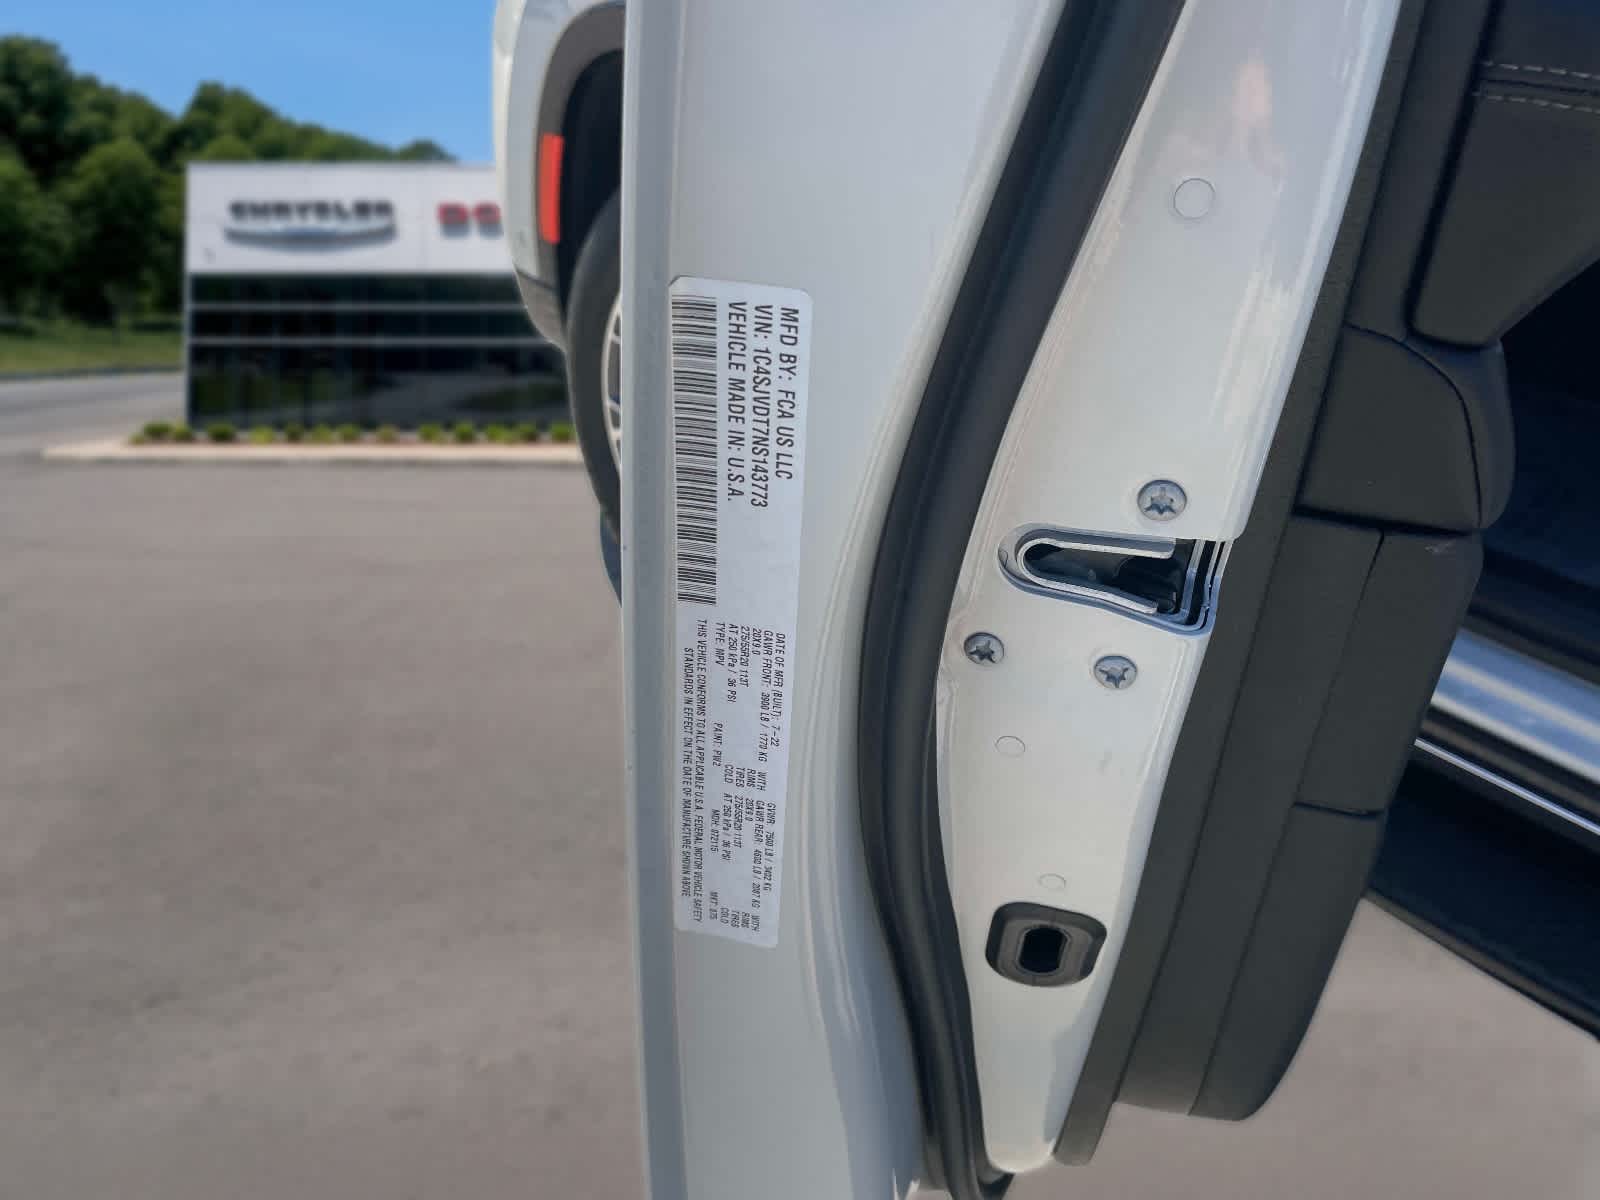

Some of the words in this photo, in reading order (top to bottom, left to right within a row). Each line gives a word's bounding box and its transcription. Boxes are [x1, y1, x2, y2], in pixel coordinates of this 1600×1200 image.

[754, 305, 772, 339] VIN:
[780, 308, 798, 346] MFD
[728, 302, 746, 370] VEHICLE
[779, 353, 797, 380] BY:
[728, 378, 745, 424] MADE
[778, 390, 795, 418] FCA
[751, 348, 772, 507] 1C4SJVDT7NS143773
[777, 427, 793, 447] US
[728, 431, 744, 450] IN:
[776, 453, 792, 479] LLC
[728, 458, 744, 501] U.S.A.
[697, 619, 707, 637] THIS
[729, 624, 738, 633] AT
[728, 637, 737, 650] 250
[740, 626, 750, 666] 275/55R20
[752, 628, 761, 655] 20X9.0
[764, 631, 773, 655] GAWR
[776, 633, 785, 654] DATE
[697, 640, 706, 672] VEHICLE
[715, 648, 724, 665] MPV
[728, 654, 737, 666] kPa
[775, 656, 784, 667] OF
[684, 648, 694, 694] STANDARDS
[740, 670, 748, 687] 113T
[762, 658, 772, 688] FRONT:
[774, 670, 783, 687] MFR
[728, 678, 736, 686] 36
[697, 674, 706, 715] CONFORMS
[728, 690, 736, 702] PSI
[761, 692, 770, 709] 3900
[684, 708, 692, 734] EFFECT
[696, 719, 705, 728] TO
[760, 713, 768, 721] LB
[684, 738, 692, 747] ON
[696, 730, 705, 744] ALL
[713, 723, 722, 746] PAINT:
[759, 733, 767, 749] 1770
[683, 750, 692, 764] THE
[712, 750, 722, 766] PW2
[758, 752, 767, 762] KG
[683, 767, 692, 785] DATE
[695, 746, 704, 790] APPLICABLE
[725, 764, 733, 783] COLD
[736, 768, 744, 787] TIRES
[746, 768, 756, 787] RIMS
[757, 772, 766, 790] WITH
[683, 788, 691, 796] OF
[724, 793, 732, 803] AT
[694, 792, 704, 812] U.S.A.
[724, 805, 732, 817] 250
[745, 798, 754, 821] 20X9.0
[756, 800, 764, 822] GAWR
[712, 809, 720, 826] MDH:
[734, 796, 743, 830] 275/55R20
[682, 798, 691, 848] MANUFACTURE
[694, 816, 703, 844] FEDERAL
[723, 819, 731, 830] kPa
[722, 840, 730, 848] 36
[765, 848, 773, 856] LB
[682, 851, 690, 874] SHOWN
[694, 847, 702, 869] MOTOR
[722, 850, 730, 860] PSI
[753, 866, 761, 874] LB
[682, 876, 690, 896] ABOVE
[694, 872, 702, 896] VEHICLE
[694, 899, 702, 922] SAFETY
[752, 899, 760, 908] KG
[752, 916, 760, 932] WITH
